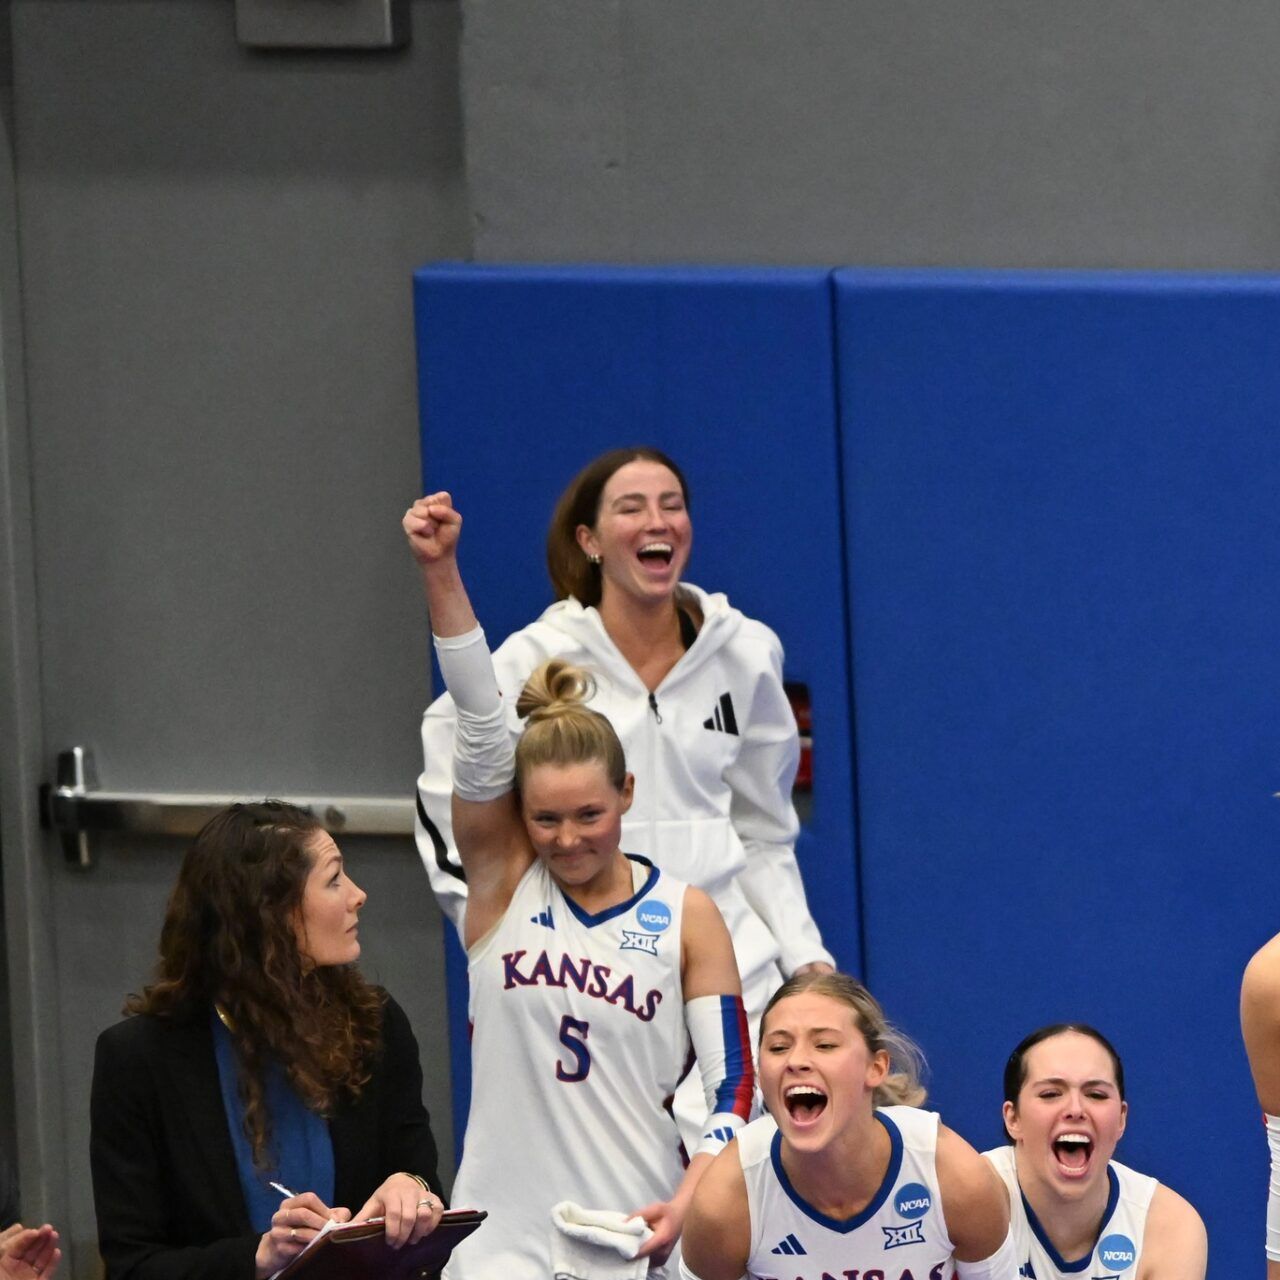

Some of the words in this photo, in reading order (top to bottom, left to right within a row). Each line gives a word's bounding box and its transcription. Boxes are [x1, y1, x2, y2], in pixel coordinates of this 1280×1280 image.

[640, 912, 669, 925] NCAA
[501, 950, 663, 1022] KANSAS
[555, 1014, 592, 1083] 5
[899, 1194, 930, 1213] NCAA
[1103, 1251, 1133, 1262] NCAA
